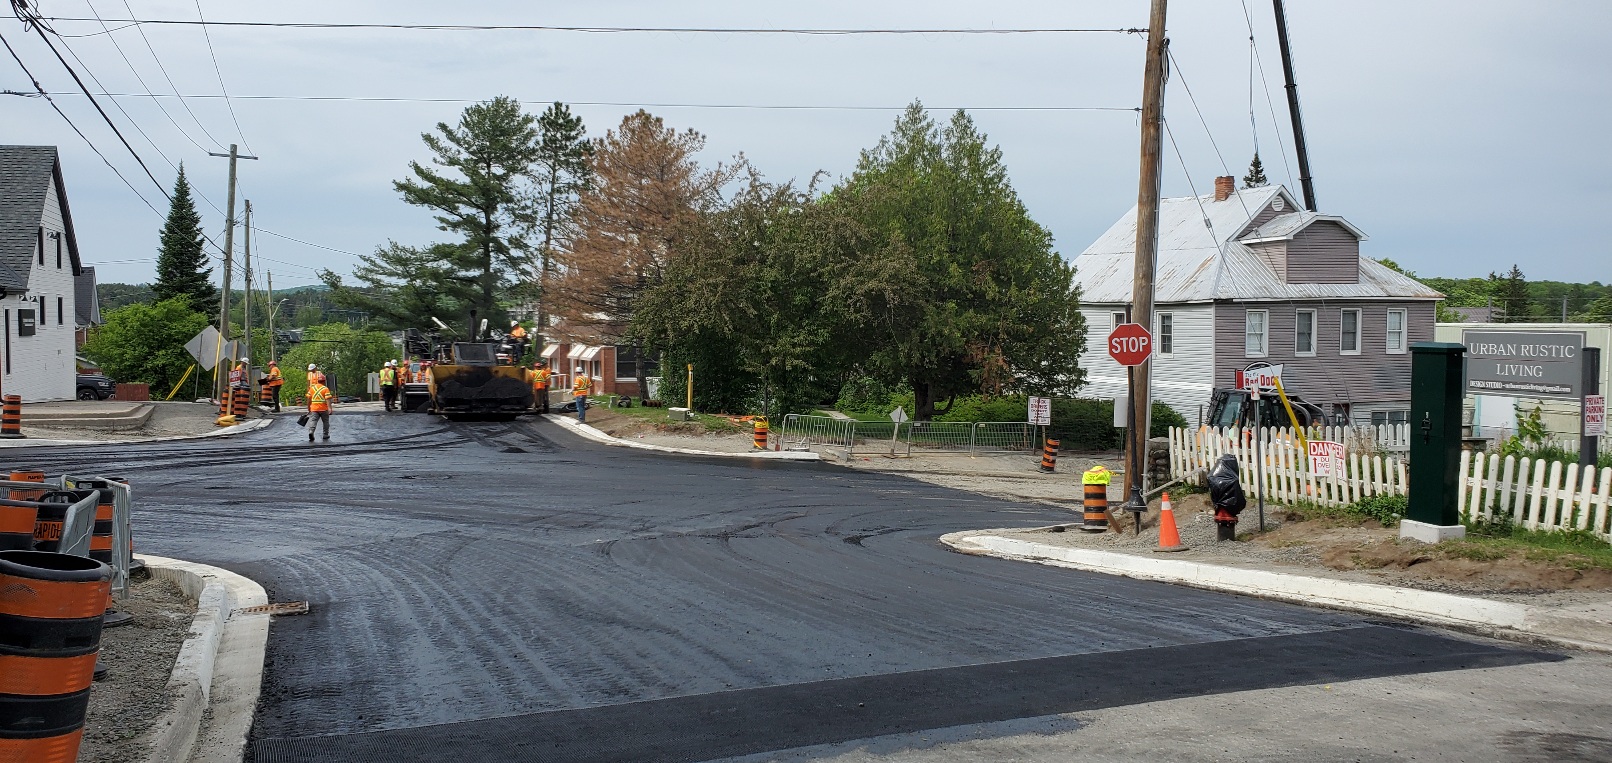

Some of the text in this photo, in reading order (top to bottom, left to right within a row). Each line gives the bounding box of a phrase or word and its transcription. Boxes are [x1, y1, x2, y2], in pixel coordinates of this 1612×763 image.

[1111, 336, 1149, 354] STOP
[1470, 343, 1575, 358] URBAN RUSTIC
[1496, 364, 1543, 377] LIVING
[1260, 374, 1279, 386] Doo
[1469, 380, 1485, 388] DESIGN
[1485, 381, 1502, 389] STUDIO
[1586, 397, 1604, 405] PRIVATE
[1586, 405, 1604, 414] PARKING
[1586, 414, 1604, 422] ONLY
